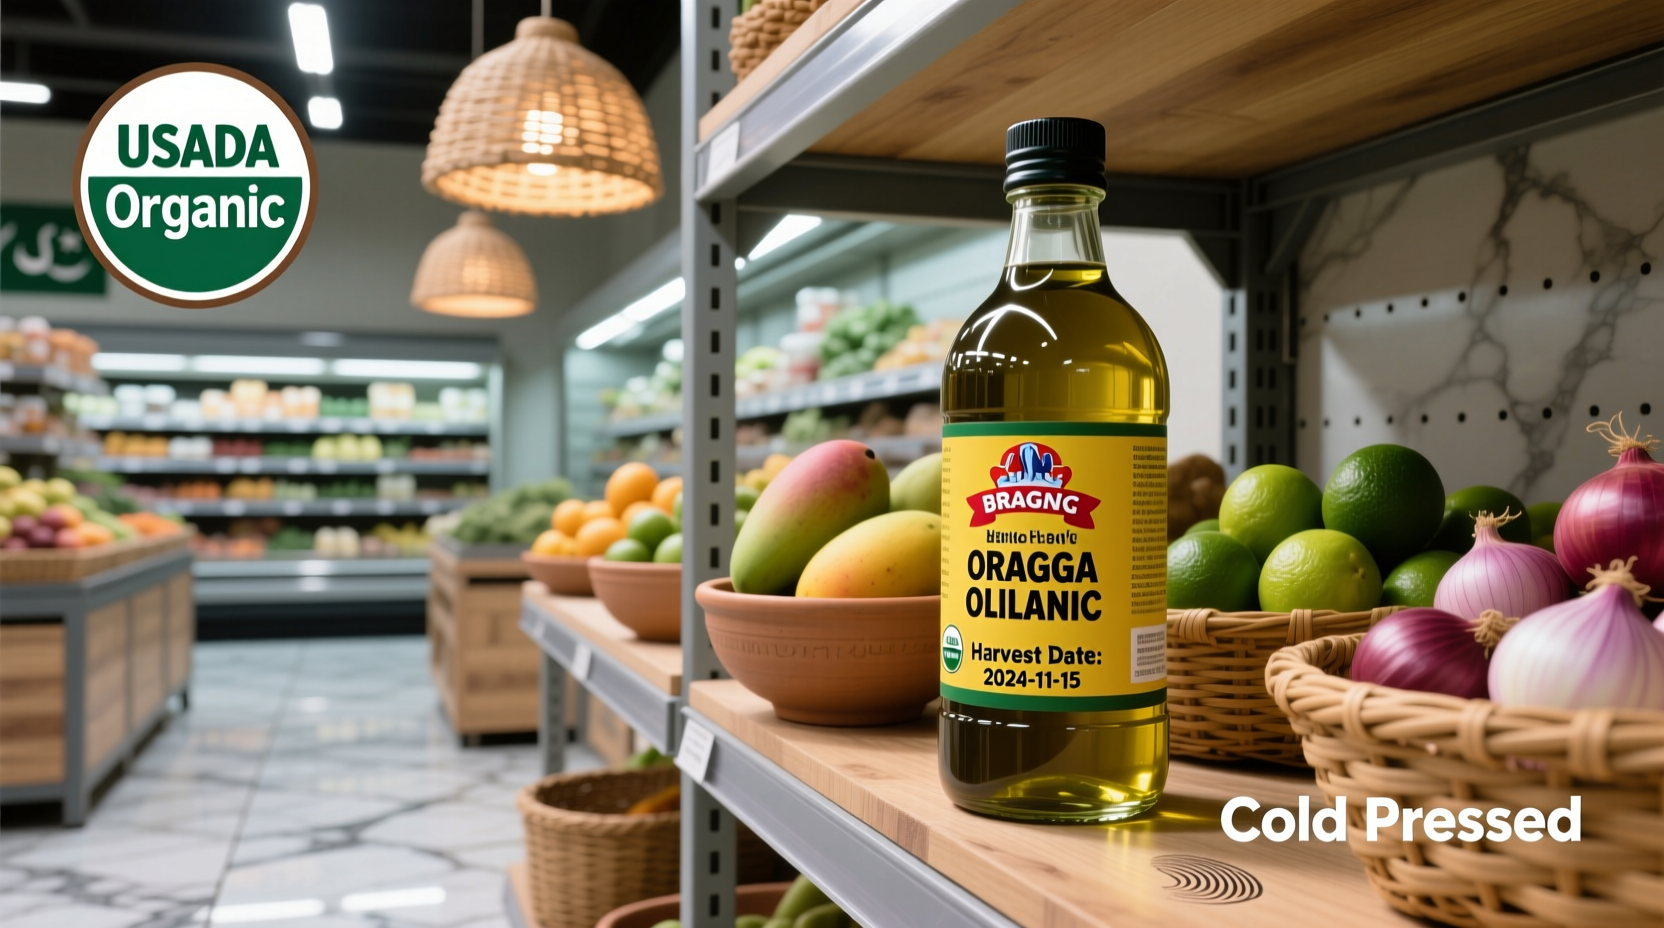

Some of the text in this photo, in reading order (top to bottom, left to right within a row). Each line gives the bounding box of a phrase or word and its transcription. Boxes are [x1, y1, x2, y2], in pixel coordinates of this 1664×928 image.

[967, 549, 1099, 583] ORAGGA
[965, 586, 1102, 622] OLILANIC
[971, 641, 1102, 666] Harvest Date:
[983, 667, 1081, 690] 2024-11-15
